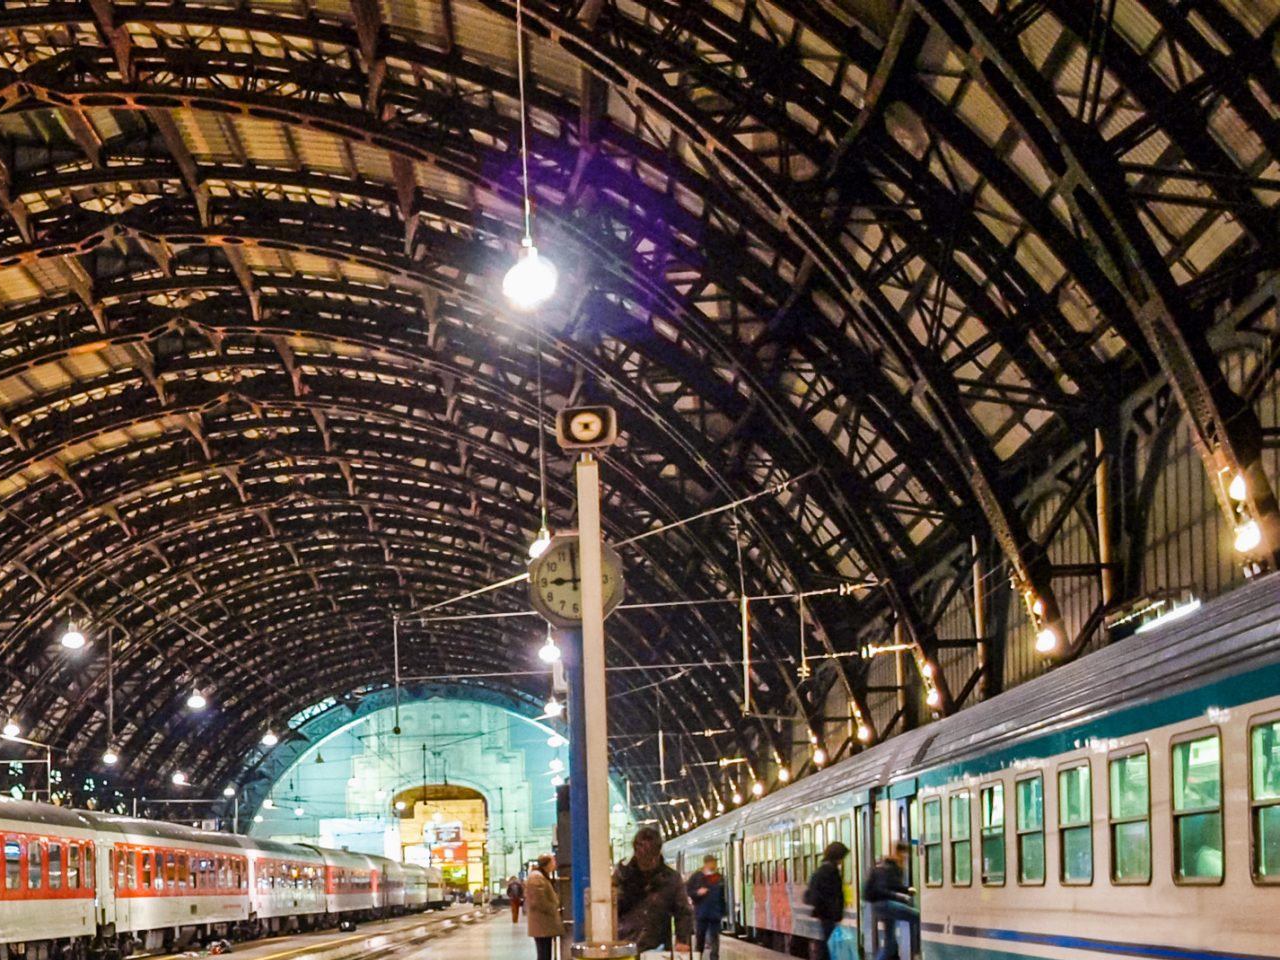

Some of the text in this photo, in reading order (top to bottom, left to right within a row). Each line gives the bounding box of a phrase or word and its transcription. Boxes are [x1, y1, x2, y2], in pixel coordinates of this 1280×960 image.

[558, 552, 566, 562] 11
[546, 562, 557, 572] 10
[540, 578, 548, 588] 9
[602, 574, 609, 584] 3
[547, 592, 554, 602] 8
[559, 601, 566, 611] 7
[572, 603, 579, 614] 6
